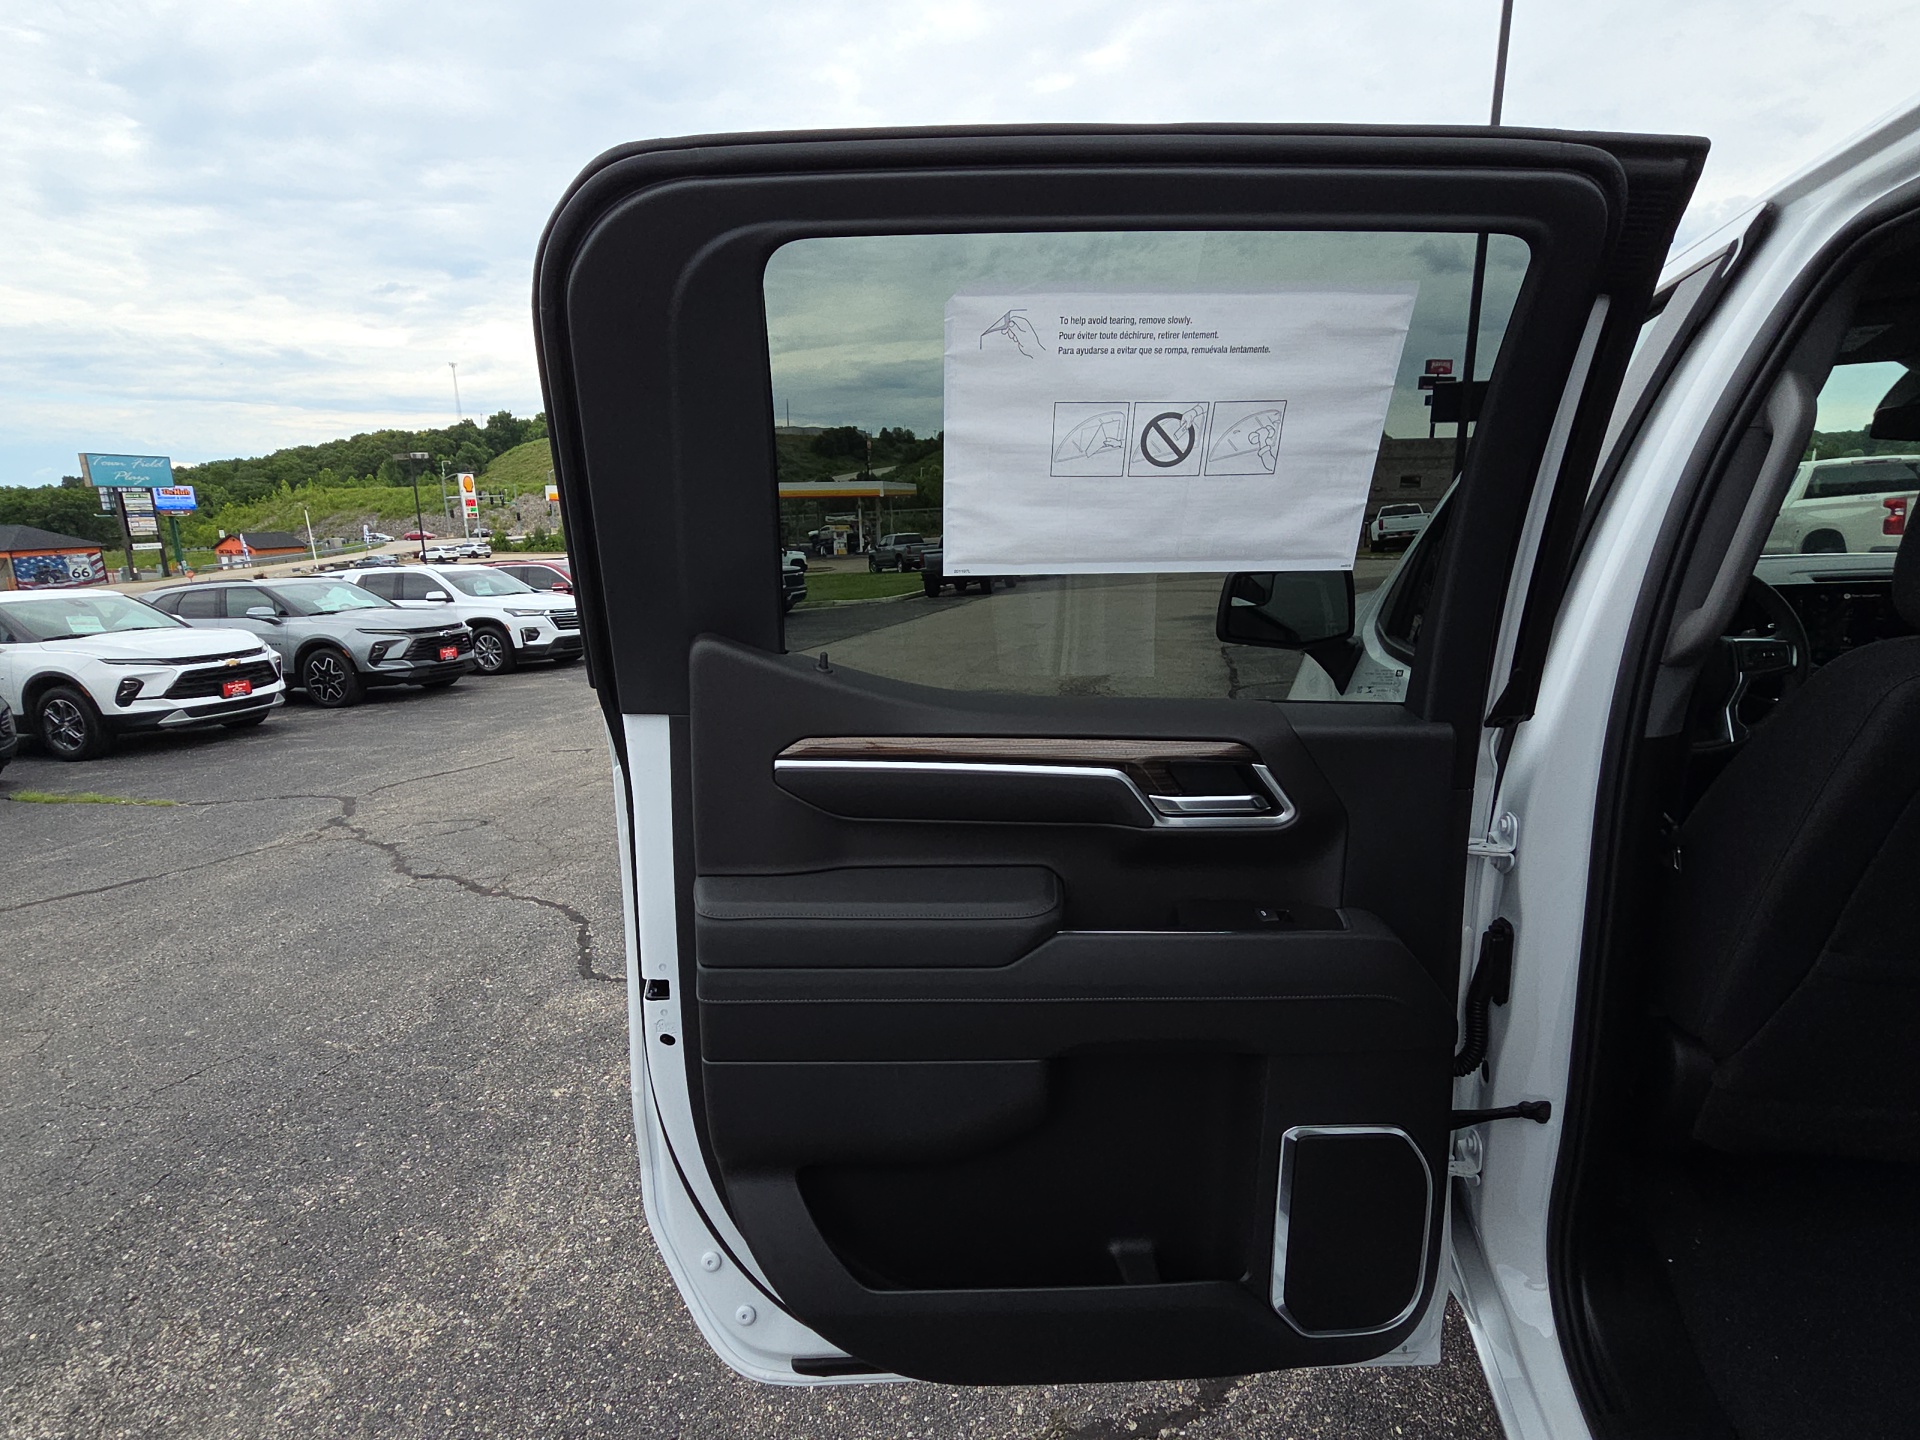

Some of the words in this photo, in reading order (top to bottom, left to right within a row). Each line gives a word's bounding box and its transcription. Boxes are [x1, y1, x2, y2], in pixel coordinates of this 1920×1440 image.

[1059, 316, 1069, 325] To
[1070, 316, 1086, 326] help
[1087, 316, 1108, 325] avoid
[1109, 316, 1137, 327] tearing,
[1138, 316, 1166, 325] remove
[1167, 315, 1193, 326] slowly.
[1058, 331, 1075, 340] Pour
[1077, 331, 1098, 340] éviter
[1099, 331, 1118, 340] toute
[1119, 331, 1156, 341] déchirure,
[1157, 331, 1180, 340] retirer
[1181, 330, 1220, 340] lentement.
[1058, 346, 1074, 355] Para
[1076, 346, 1109, 356] ayudarse
[1110, 347, 1116, 355] a
[1116, 346, 1138, 355] evitar
[1138, 347, 1153, 356] que
[1154, 347, 1163, 355] se
[1164, 346, 1190, 356] rompa,
[1191, 345, 1228, 355] remuévala
[1229, 344, 1271, 354] lentamente.
[131, 457, 165, 469] Field
[72, 567, 90, 578] 66
